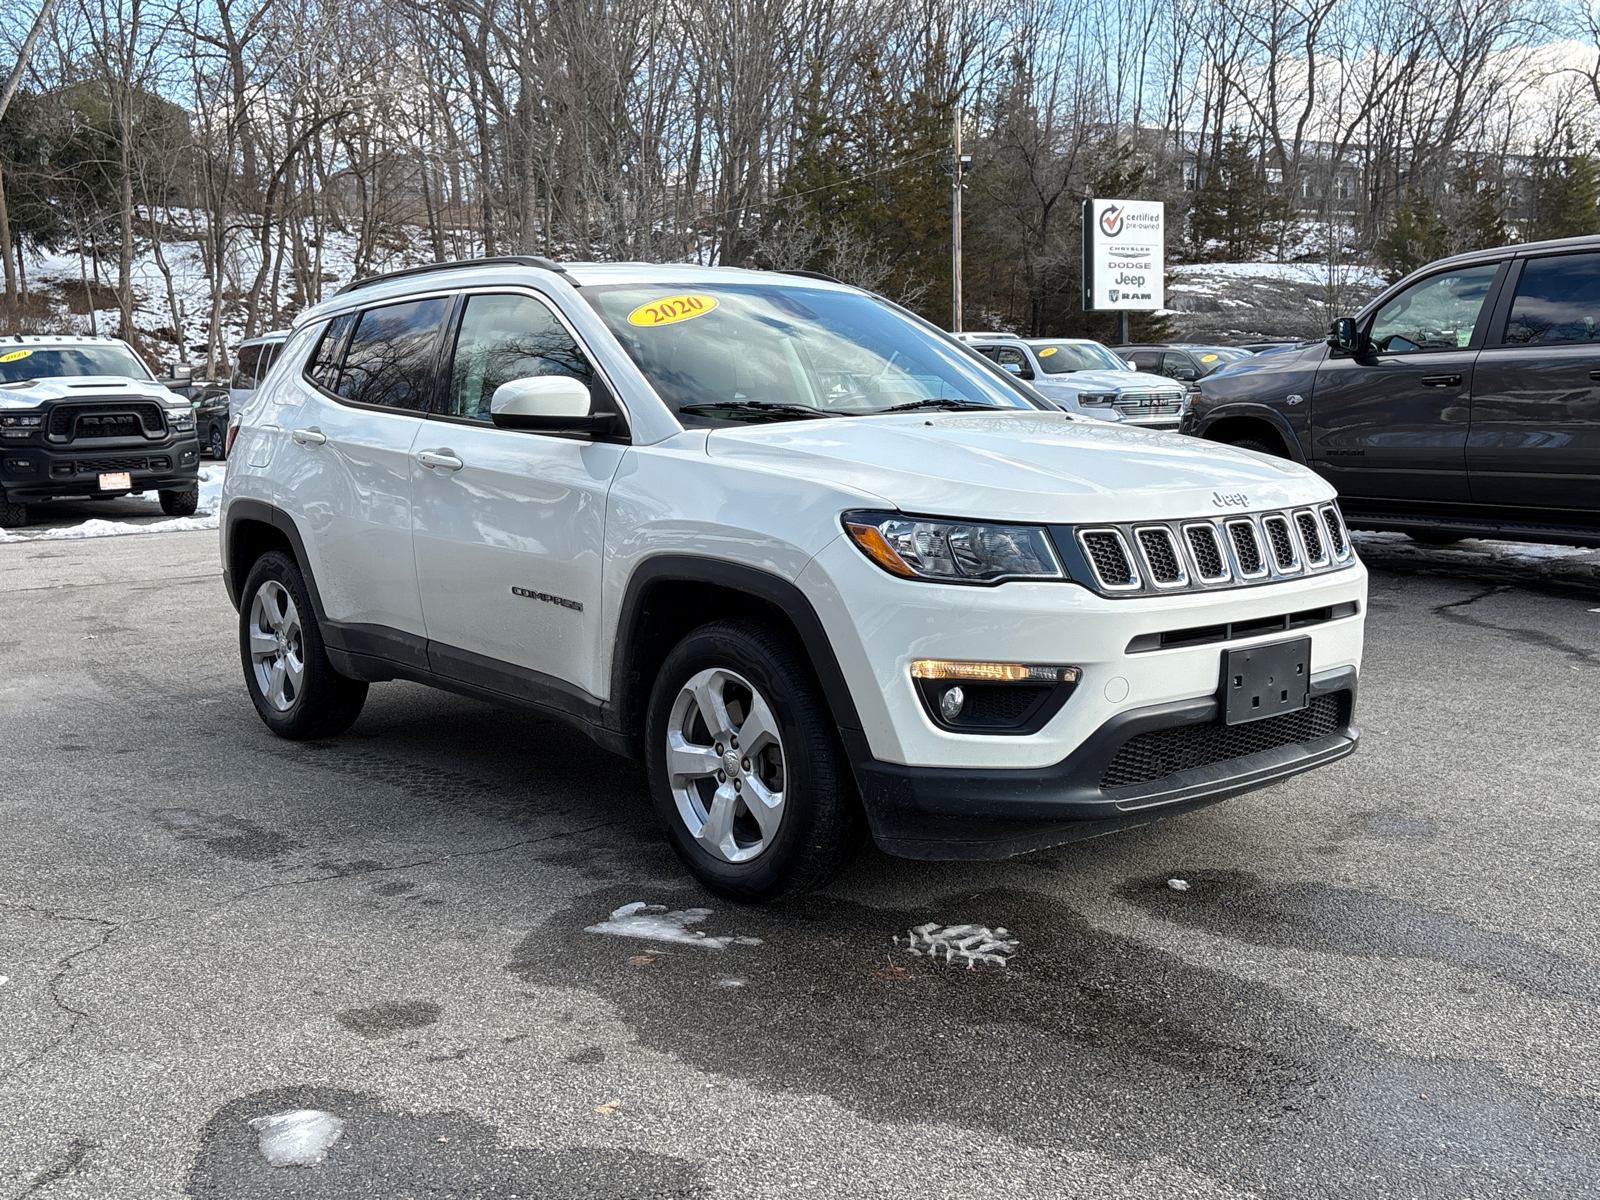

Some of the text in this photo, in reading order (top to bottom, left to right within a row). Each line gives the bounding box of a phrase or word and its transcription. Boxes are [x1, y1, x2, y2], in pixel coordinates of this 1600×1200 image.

[1126, 213, 1160, 222] certified
[1126, 222, 1160, 230] pre-owned
[1115, 272, 1145, 288] Jeep
[645, 297, 704, 323] 2020
[1141, 399, 1168, 407] RAM
[82, 416, 134, 426] RAM
[1212, 491, 1249, 508] Jeep
[511, 586, 584, 612] COMPASS
